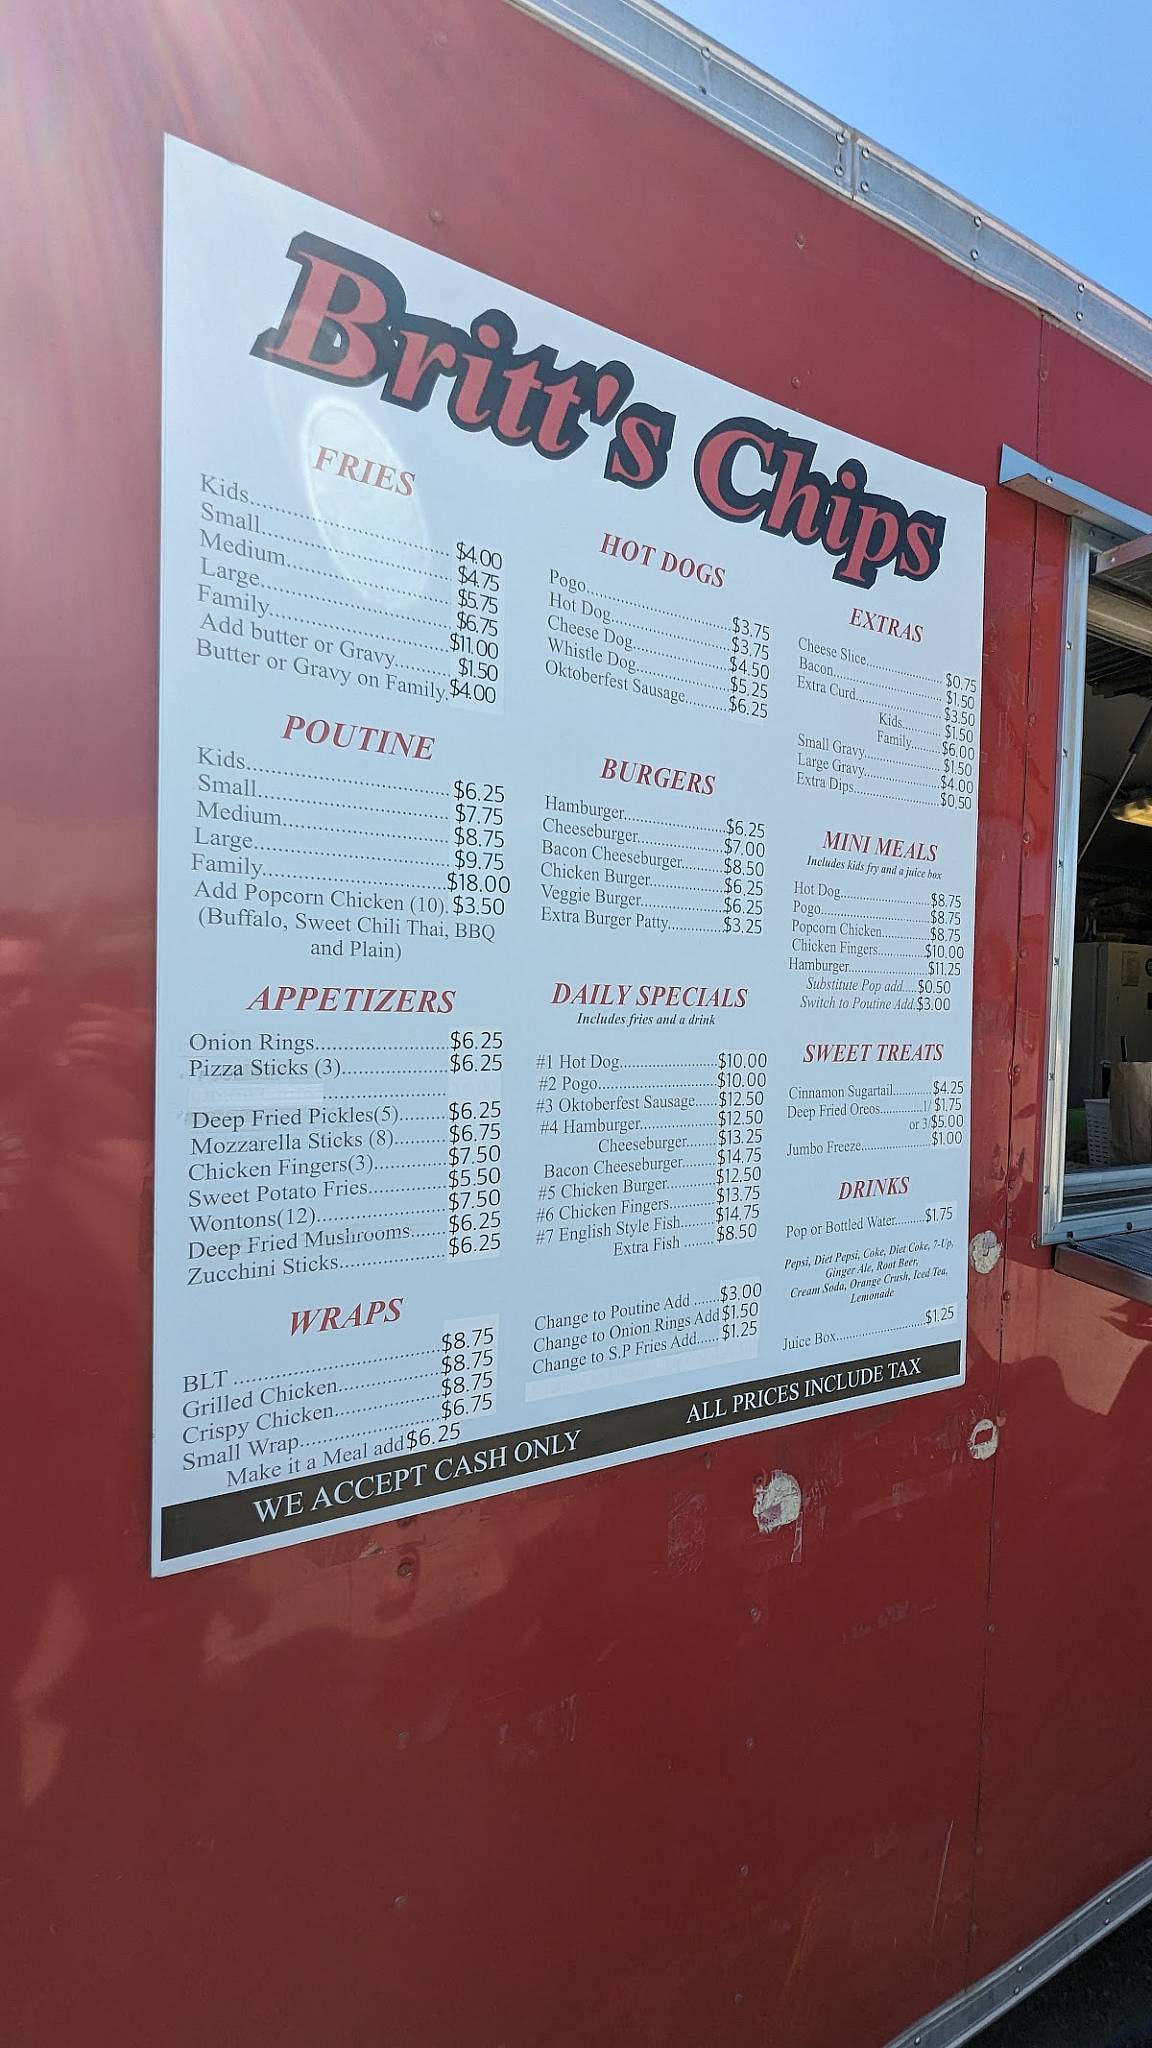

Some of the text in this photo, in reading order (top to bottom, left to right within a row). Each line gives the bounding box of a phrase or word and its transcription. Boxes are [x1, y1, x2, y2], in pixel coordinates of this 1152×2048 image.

[250, 231, 946, 589] Britt's Chips
[312, 445, 416, 496] FRIES
[456, 541, 503, 570] $4.00
[599, 532, 726, 588] HOT DOGS
[458, 565, 500, 592] $4.75
[549, 591, 576, 613] Hot
[732, 637, 769, 660] $3.75
[849, 607, 923, 642] EXTRAS
[196, 638, 260, 666] Butter
[267, 655, 287, 669] or
[293, 657, 351, 686] Gravy
[357, 671, 379, 687] on
[449, 678, 496, 704] $4.00
[798, 637, 837, 658] Cheese
[946, 673, 976, 693] $0.75
[545, 659, 628, 690] Oktoberfest
[729, 695, 768, 718] $6.25
[281, 714, 436, 761] POUTINE
[798, 733, 829, 751] Small
[943, 759, 972, 776] $1.50
[600, 758, 715, 795] BURGERS
[454, 826, 505, 848] $8.75
[725, 838, 765, 857] $7.00
[822, 831, 938, 862] MINI MEALS
[447, 872, 510, 894] $18.00
[806, 856, 845, 869] Includes
[847, 861, 864, 872] kids
[866, 863, 879, 875] fry
[881, 866, 897, 875] and
[905, 868, 926, 878] juice
[927, 869, 942, 880] box
[194, 881, 238, 900] Add
[244, 883, 324, 906] Popcorn
[331, 890, 404, 912] Chicken
[453, 895, 505, 916] $3.50
[198, 907, 495, 943] (Buffalo, Sweet Chili Thai, BBQ
[541, 906, 579, 923] Extra
[585, 910, 631, 929] Burger
[723, 916, 762, 934] $3.25
[792, 919, 836, 937] Popcorn
[930, 927, 960, 942] $8.75
[310, 940, 402, 961] and Plain)
[246, 985, 456, 1014] APPETIZERS
[551, 982, 748, 1007] DAILY SPECIALS
[800, 995, 835, 1009] Switch
[839, 999, 849, 1009] to
[852, 996, 891, 1010] Poutine
[916, 997, 950, 1012] $3.00
[576, 1013, 715, 1027] Includes fries and a drink
[189, 1033, 252, 1051] Onion
[450, 1030, 503, 1052] $6.25
[803, 1043, 944, 1063] SWEET TREATS
[189, 1060, 243, 1077] Pizza
[250, 1059, 308, 1076] Sticks
[450, 1053, 503, 1074] $6.25
[539, 1076, 556, 1091] #2
[717, 1072, 766, 1088] $10.00
[789, 1086, 844, 1100] Cinnamon
[933, 1080, 964, 1095] $4.25
[192, 1111, 244, 1132] Deep
[252, 1110, 301, 1126] Fried
[449, 1101, 501, 1122] $6.25
[787, 1142, 823, 1156] Jumbo
[932, 1131, 962, 1146] $1.00
[189, 1189, 249, 1208] Sweet
[257, 1184, 316, 1202] Potato
[449, 1168, 501, 1189] $5.50
[538, 1186, 555, 1200] #5
[561, 1182, 618, 1199] Chicken
[716, 1167, 761, 1185] $12.50
[838, 1177, 910, 1200] DRINKS
[786, 1225, 807, 1240] Pop
[811, 1224, 822, 1235] or
[825, 1217, 863, 1233] Bottled
[925, 1207, 953, 1222] $1.75
[814, 1255, 832, 1266] Diet
[889, 1245, 906, 1255] Diet
[534, 1315, 588, 1331] Change
[593, 1310, 606, 1321] to
[611, 1303, 660, 1319] Poutine
[720, 1283, 762, 1302] $3.00
[850, 1289, 894, 1303] Lemonade
[290, 1297, 404, 1336] WRAPS
[783, 1336, 811, 1351] Juice
[925, 1306, 954, 1324] $1.25
[183, 1327, 494, 1393] BLT $8.75
[182, 1388, 253, 1418] Grilled
[441, 1349, 494, 1375] $8.75
[687, 1357, 922, 1424] ALL PRICES INCLUDE TAX
[226, 1467, 281, 1488] Make
[287, 1461, 302, 1473] it
[306, 1459, 317, 1469] a
[324, 1447, 367, 1467] Meal
[406, 1422, 461, 1450] $6.25
[252, 1429, 582, 1523] WE ACCEPT CASH ONLY
